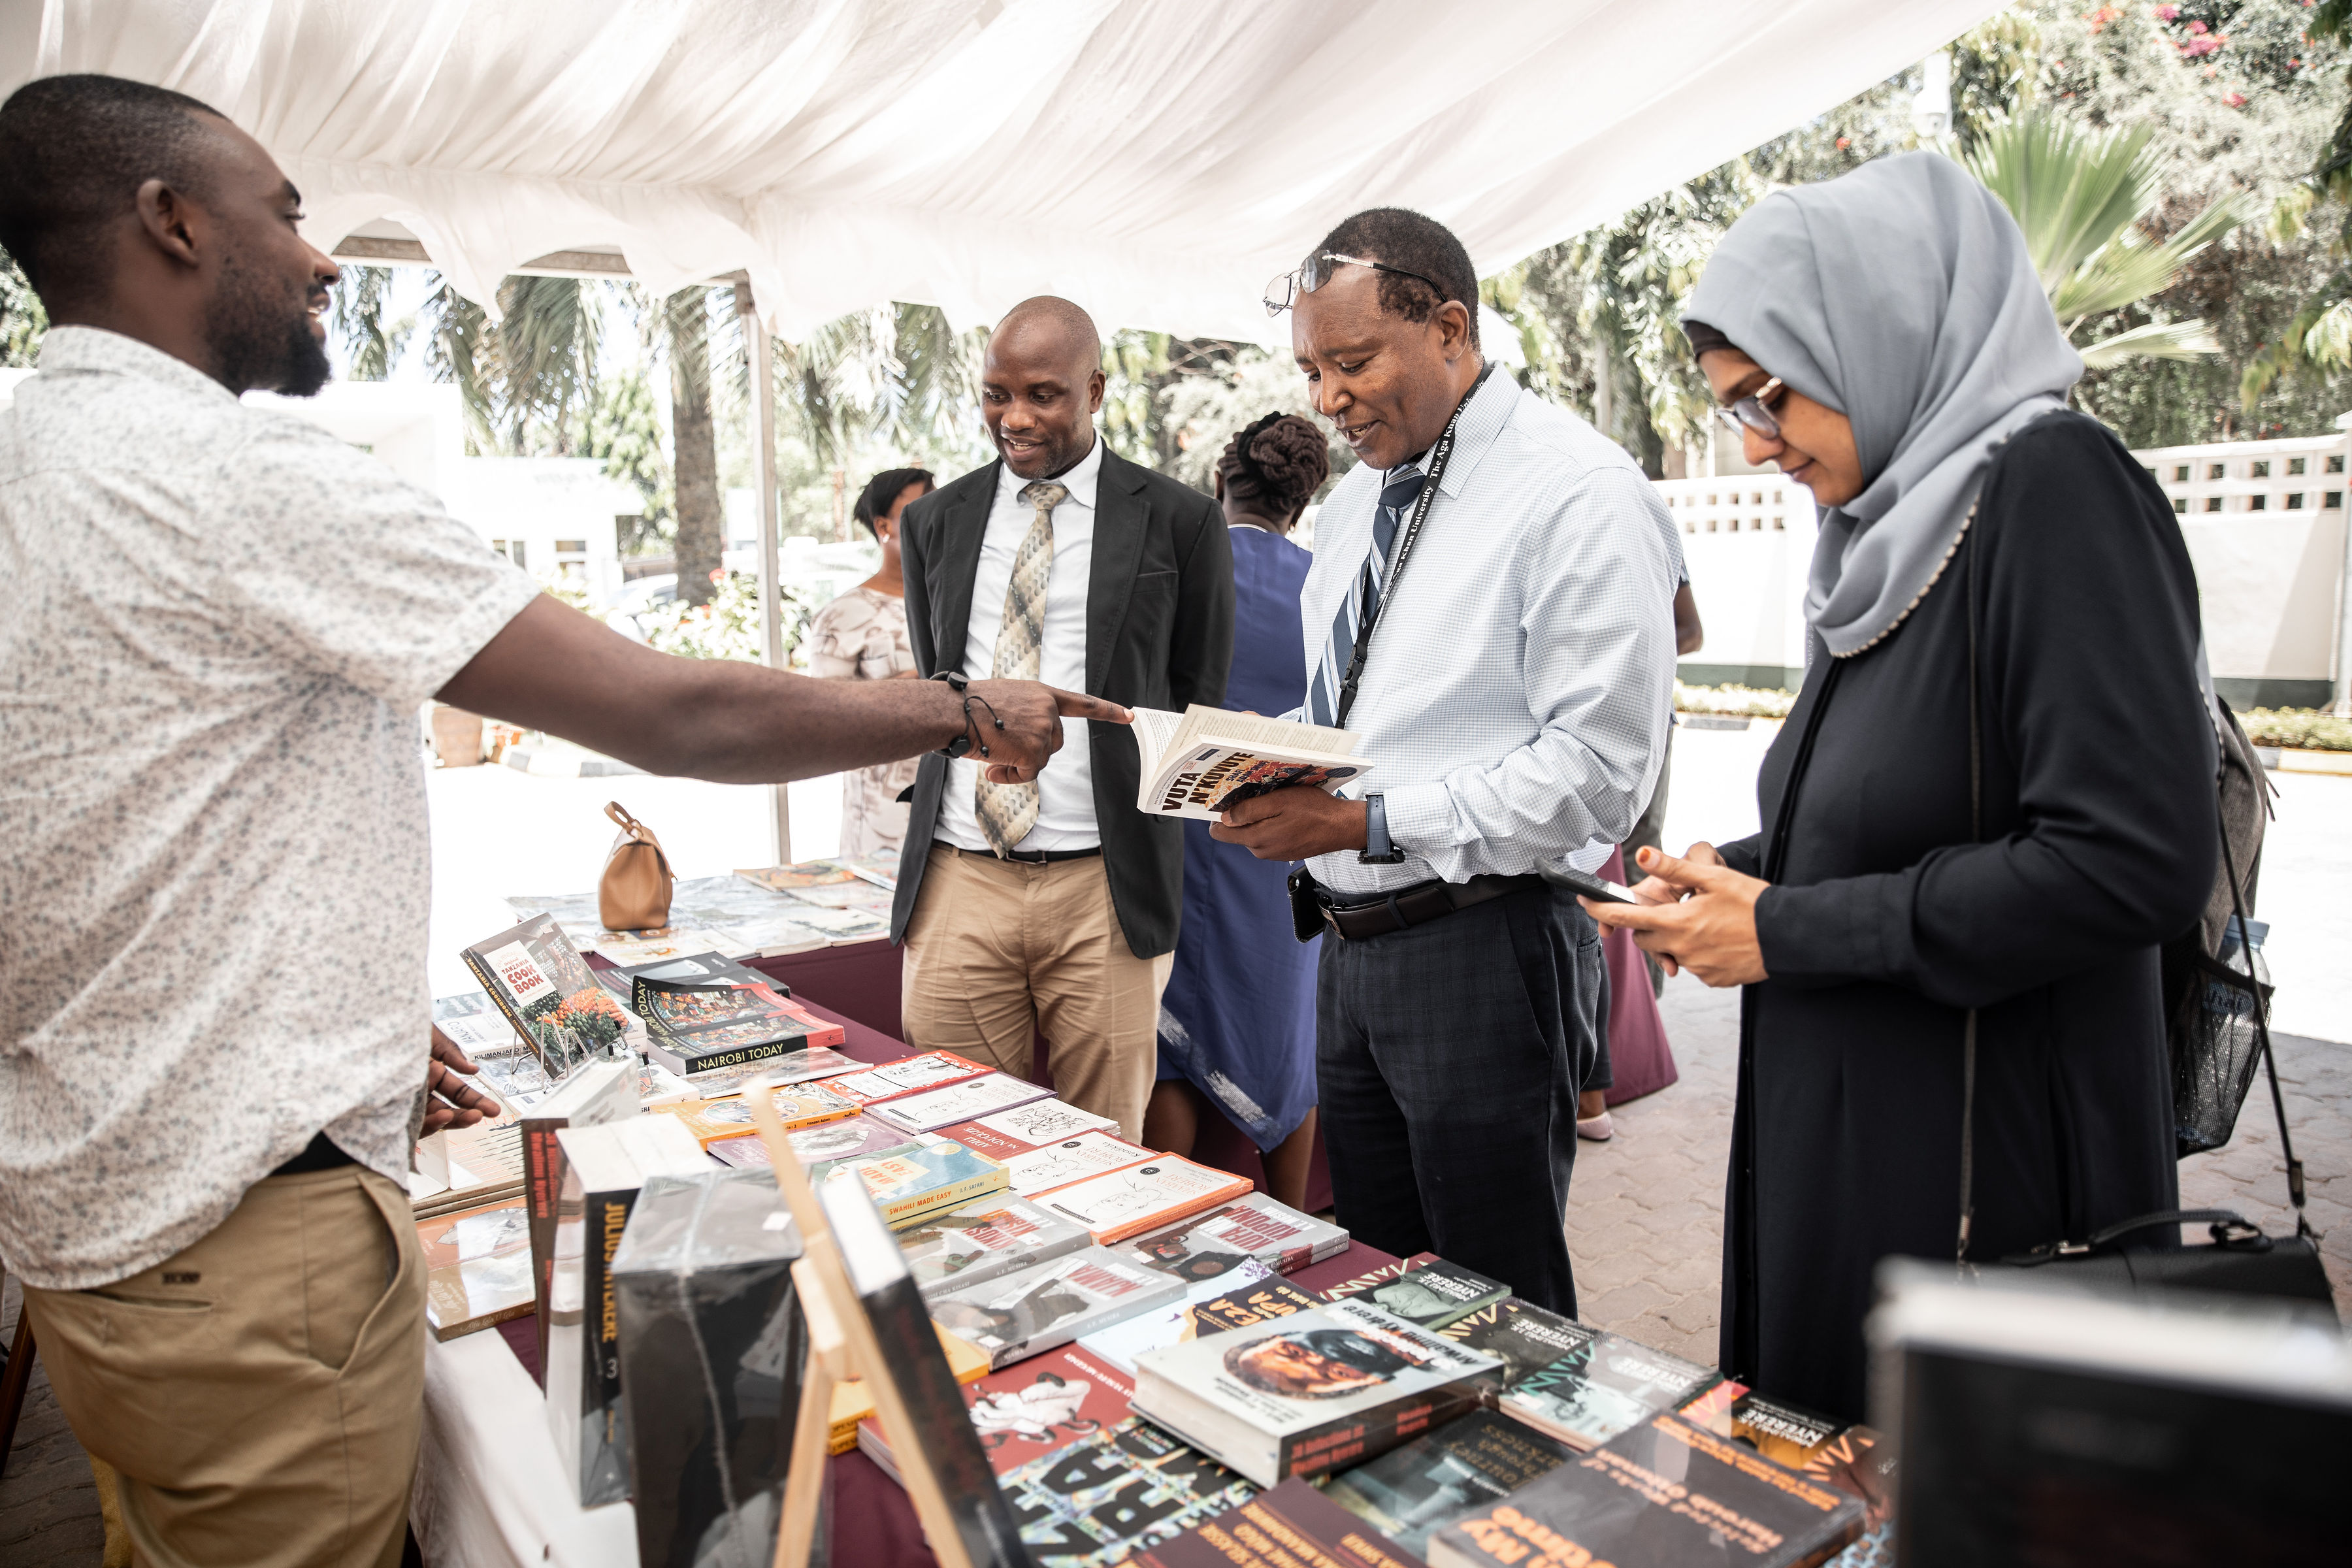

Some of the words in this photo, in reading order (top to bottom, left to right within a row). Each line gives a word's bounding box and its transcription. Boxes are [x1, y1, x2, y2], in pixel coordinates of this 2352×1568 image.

[1429, 461, 1442, 479] The
[1436, 436, 1450, 460] Aga
[1443, 410, 1461, 438] Khan
[1458, 380, 1485, 412] University
[1400, 535, 1414, 560] Khan
[1411, 485, 1433, 532] University
[1187, 751, 1256, 804] N'KUVUTE
[1226, 768, 1245, 782] SHAFI
[1162, 772, 1203, 811] VUTA
[501, 958, 530, 975] TANZANIA
[503, 956, 519, 967] Original
[506, 964, 538, 985] COOK
[466, 956, 491, 990] TANZANIA
[487, 987, 513, 1019] COOKBOOK
[513, 973, 545, 996] BOOK
[638, 981, 647, 1017] TODAY
[645, 1015, 672, 1037] NAIROBI
[697, 1050, 746, 1071] NAIROBI
[747, 1043, 785, 1060] TODAY
[963, 1126, 1009, 1147] NDUGUZE
[963, 1136, 992, 1149] ADILI
[881, 1160, 915, 1177] EASY
[889, 1201, 915, 1215] SWAHILI
[917, 1195, 934, 1207] MADE
[936, 1190, 952, 1201] EASY
[968, 1181, 985, 1191] SAFARI
[603, 1201, 627, 1264] JULIUS
[1196, 1215, 1238, 1235] NA
[1222, 1204, 1303, 1241] KUPONA
[1217, 1225, 1276, 1252] KUFA
[951, 1281, 971, 1294] KISASI
[1009, 1261, 1028, 1273] MUSIBA
[1424, 1271, 1480, 1298] NYERERE
[1516, 1318, 1581, 1348] NYERERE
[1743, 1408, 1823, 1443] NYERERE
[1460, 1517, 1531, 1566] My
